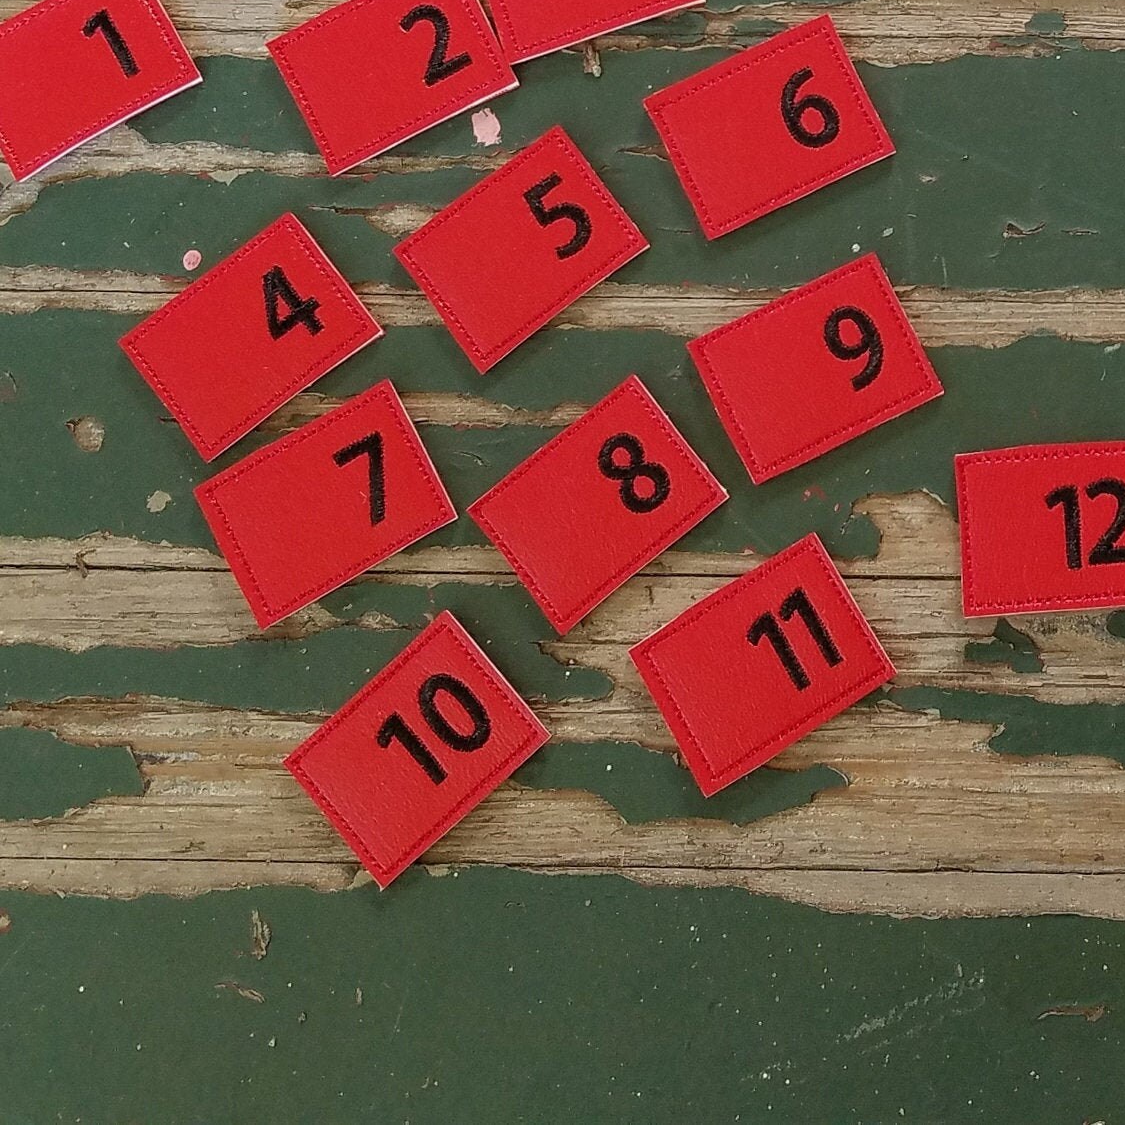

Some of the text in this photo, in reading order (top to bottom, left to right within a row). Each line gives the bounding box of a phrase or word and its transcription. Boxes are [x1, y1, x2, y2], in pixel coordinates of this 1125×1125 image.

[82, 9, 139, 76] 1
[399, 4, 473, 86] 2
[780, 68, 840, 149] 6
[523, 174, 592, 260] 5
[262, 265, 323, 340] 4
[823, 307, 884, 392] 9
[333, 432, 386, 525] 7
[597, 432, 671, 515] 8
[746, 588, 844, 692] 11
[376, 672, 492, 786] 10
